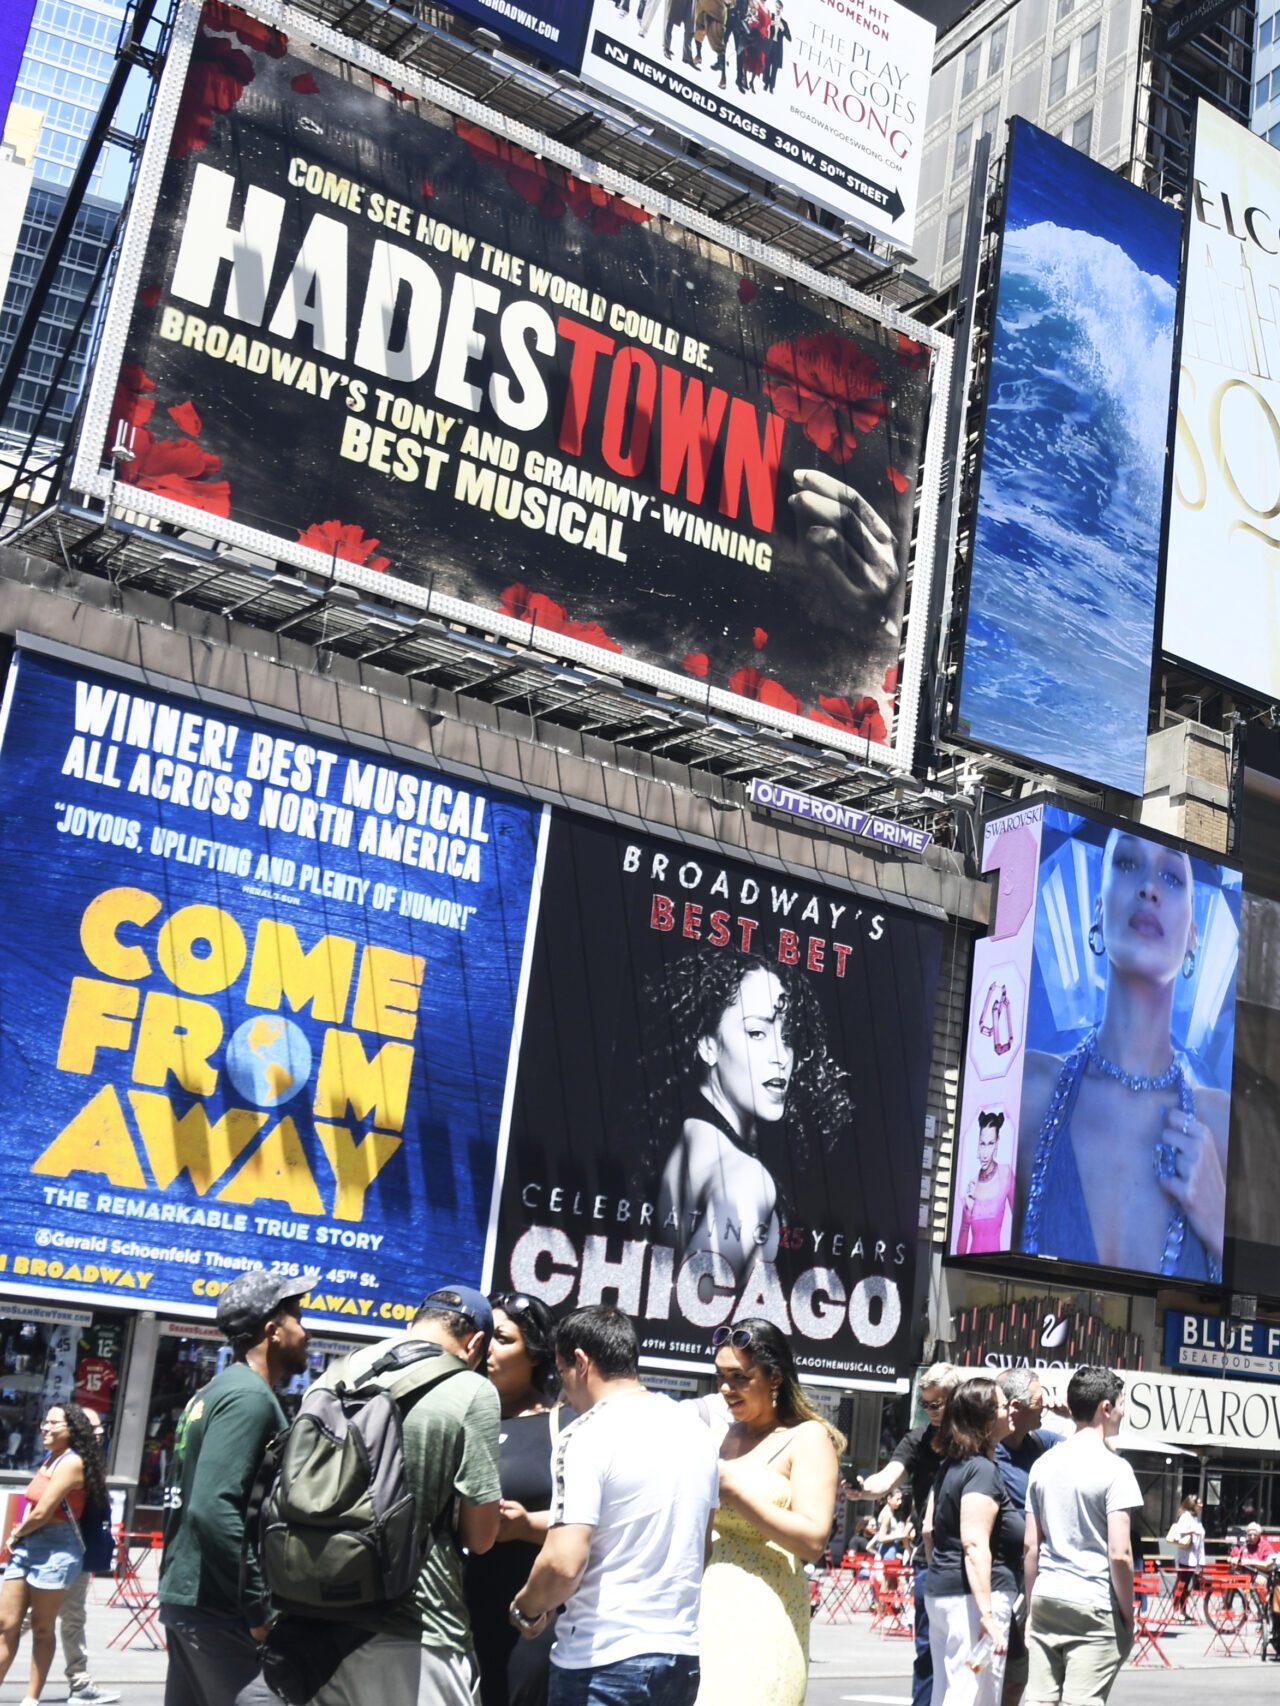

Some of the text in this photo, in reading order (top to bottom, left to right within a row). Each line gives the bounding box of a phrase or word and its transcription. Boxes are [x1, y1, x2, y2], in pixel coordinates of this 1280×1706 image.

[478, 0, 560, 42] BROADWAY.COM
[809, 21, 910, 91] THE PLAY
[868, 5, 890, 25] HIT
[792, 61, 913, 159] WRONG
[795, 37, 917, 125] THAT GOES
[632, 57, 668, 85] NEW
[668, 75, 718, 113] WORLD
[719, 106, 768, 141] STAGES
[774, 136, 801, 158] 340
[801, 150, 817, 168] W.
[846, 175, 890, 207] STREET
[790, 104, 903, 173] BROADWAYGOESWRONG.COM
[288, 156, 715, 375] COME SEE HOW THE WORLD COULD BE.
[160, 305, 370, 413] BROADWAY'S
[459, 429, 520, 474] AND
[169, 162, 786, 534] HADESTOWN
[340, 418, 629, 564] BEST MUSICAL
[74, 680, 490, 843] WINNER! BEST MUSICAL
[61, 735, 483, 883] ALL ACROSS NORTH AMERICA
[985, 806, 1042, 840] SWAROVSKI
[54, 801, 478, 932] "JOYOUS, UPLIFTING AND PLENTY OF HUMOR!"
[622, 844, 886, 942] BROADWAY'S
[79, 886, 427, 1041] COME
[650, 894, 854, 979] BEST BET
[31, 1083, 403, 1223] AWAY
[43, 1186, 385, 1252] THE REMARKABLE TRUE STORY
[51, 1231, 108, 1254] Gerald
[111, 1238, 200, 1267] Schoenfeld
[270, 1259, 300, 1279] 236
[360, 1272, 380, 1289] St.
[522, 1182, 907, 1267] CELEBRATING 25 YEARS
[13, 1254, 155, 1291] BROADWAY
[509, 1224, 903, 1349] CHICAGO
[97, 1339, 113, 1358] 12
[641, 1338, 716, 1356] 49TH STREET AT
[1181, 1350, 1251, 1369] SEAFOOD
[1182, 1315, 1254, 1354] BLUE
[86, 1372, 102, 1392] 15
